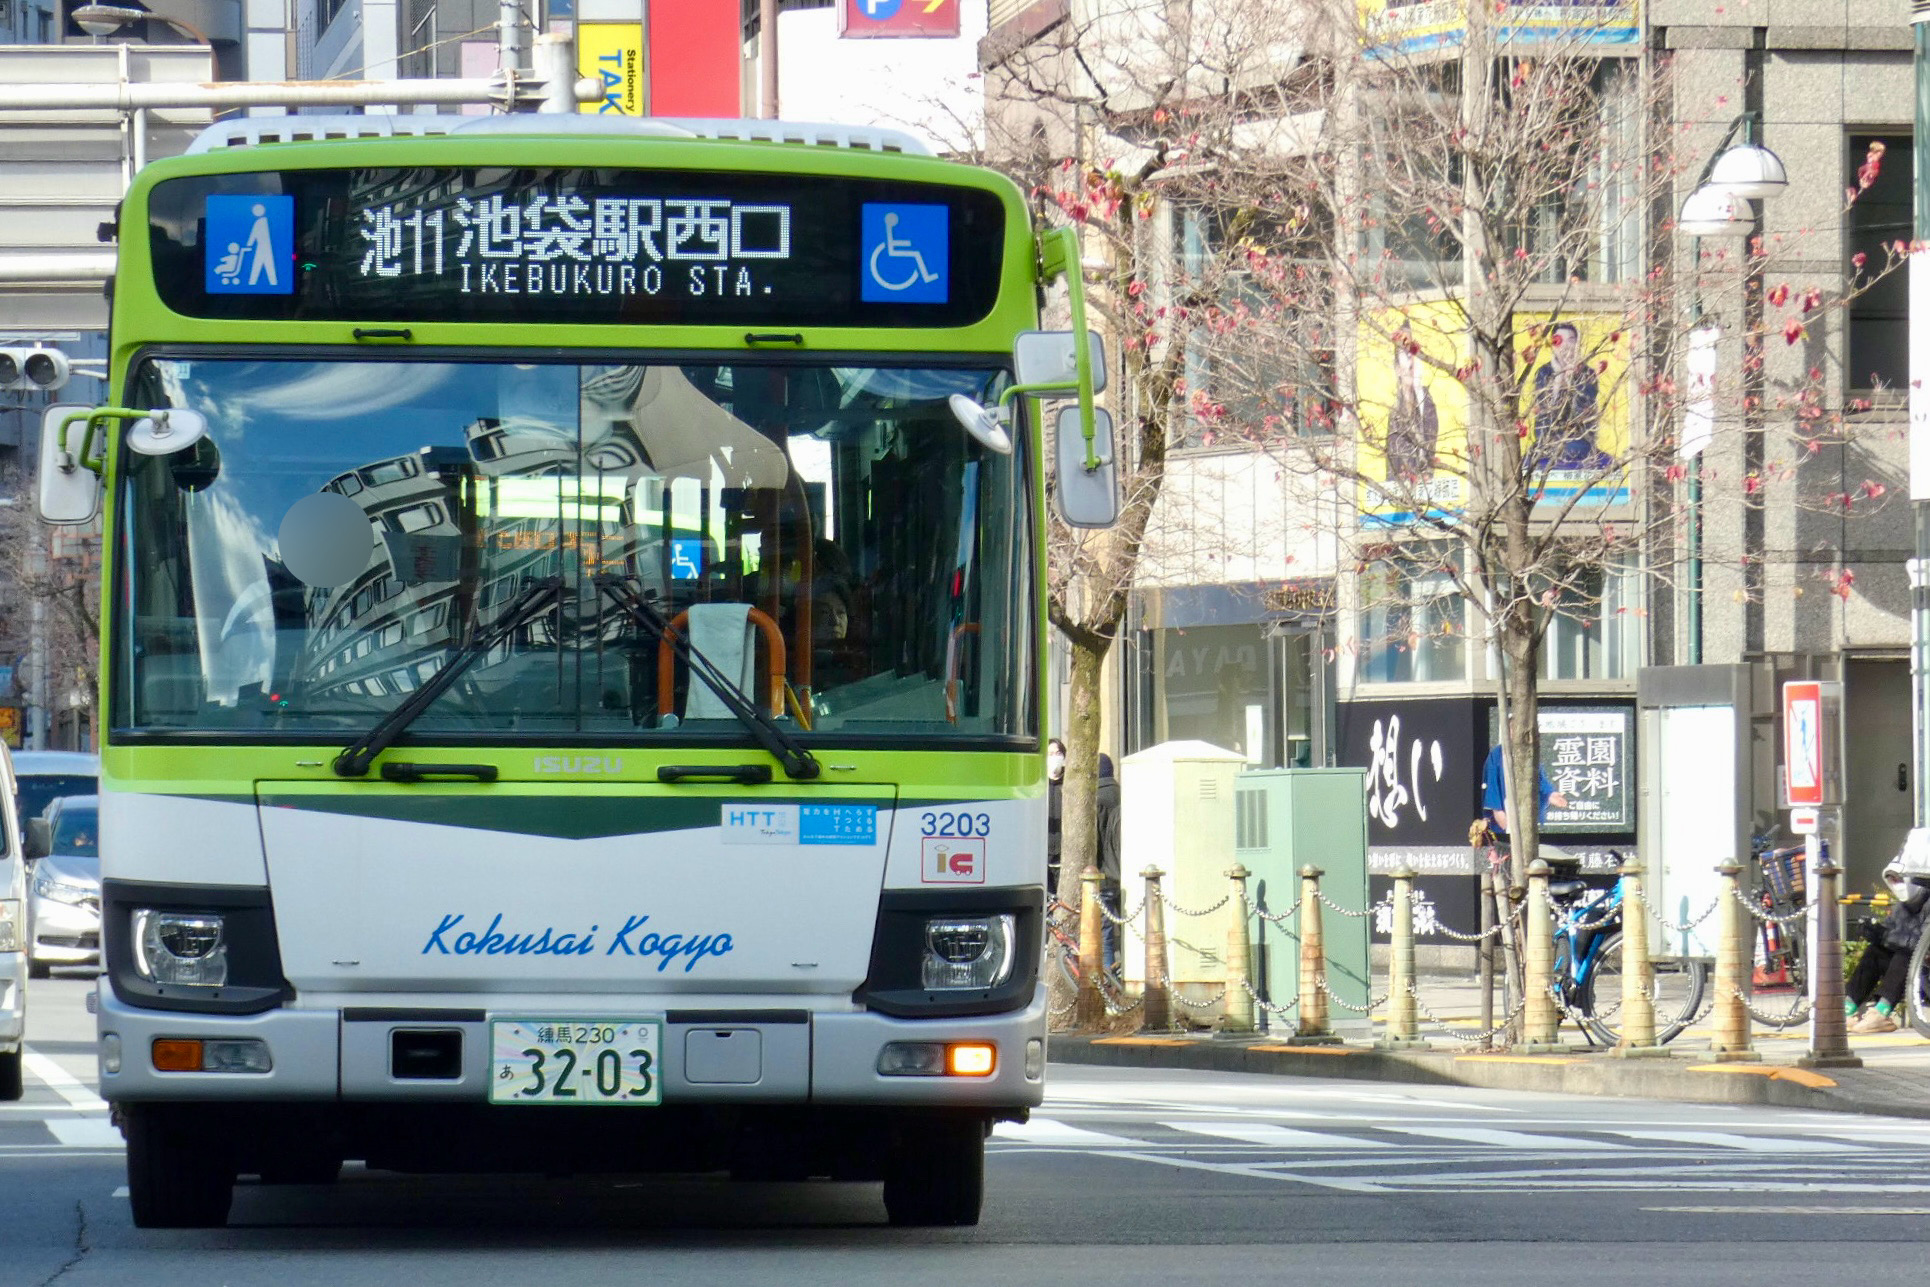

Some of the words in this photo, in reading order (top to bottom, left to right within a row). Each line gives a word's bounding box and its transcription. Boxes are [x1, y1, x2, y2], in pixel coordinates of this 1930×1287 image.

[626, 49, 636, 112] Stationery
[454, 195, 790, 261] 池袋駅西口
[460, 263, 662, 294] IKEBUKURO
[689, 265, 772, 296] STA.
[534, 757, 622, 773] ISUZU
[1551, 736, 1616, 767] 霊園
[1366, 714, 1443, 829] 想い
[1552, 767, 1619, 798] 資料
[730, 811, 775, 826] HTT
[921, 812, 990, 837] 3203
[421, 913, 598, 955] Kokusai
[606, 915, 733, 972] Kogyo
[500, 1064, 514, 1080] あ
[521, 1048, 653, 1096] 32-03
